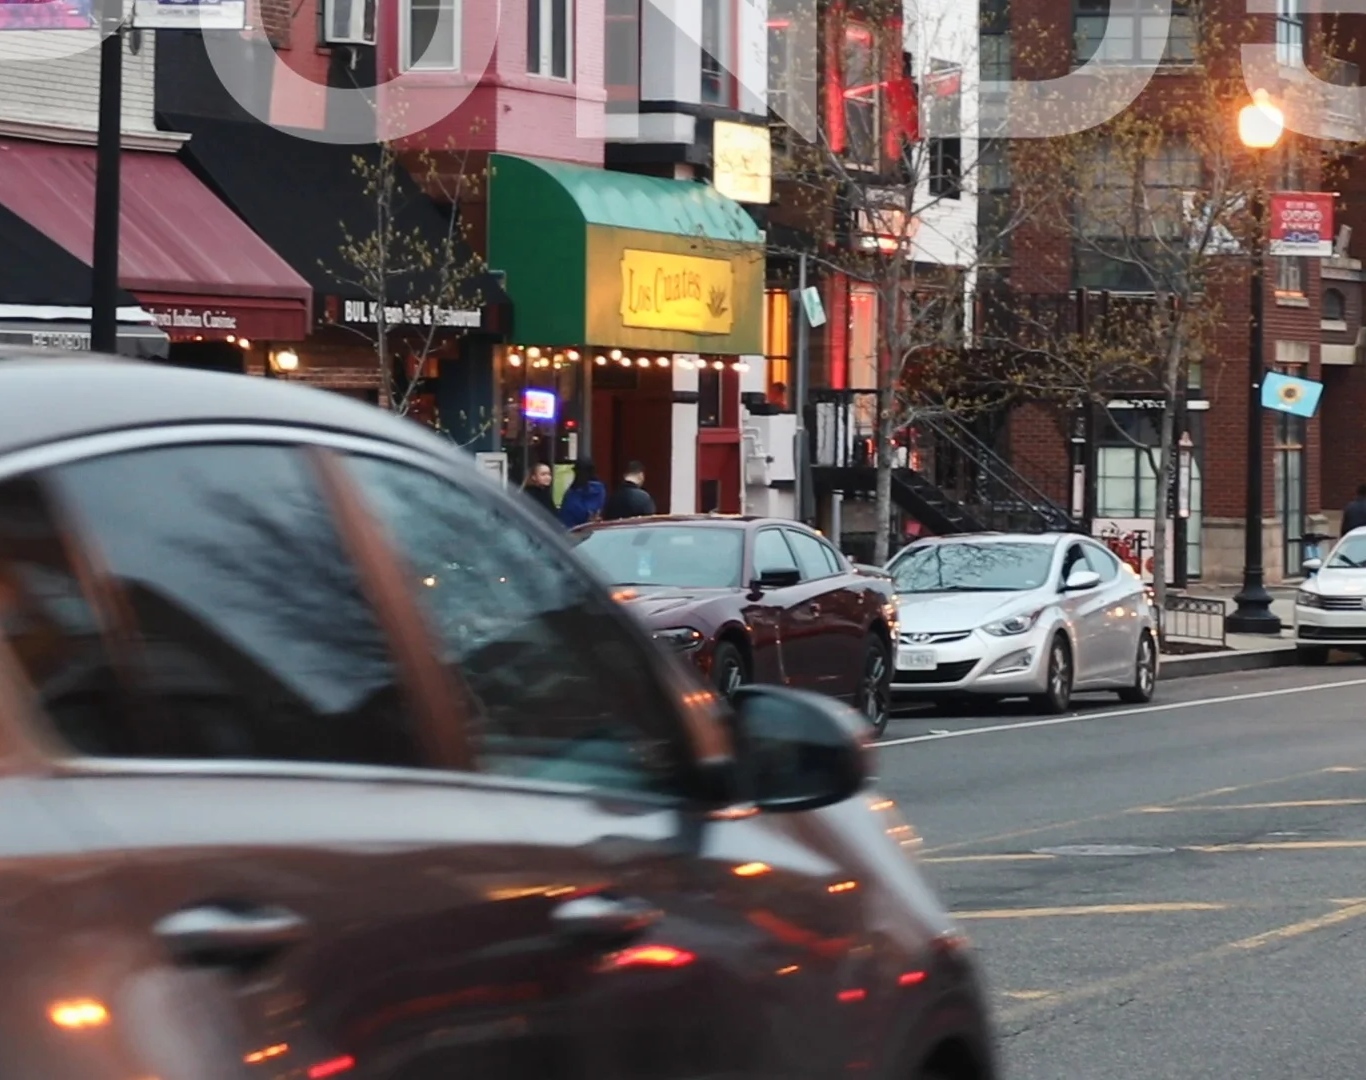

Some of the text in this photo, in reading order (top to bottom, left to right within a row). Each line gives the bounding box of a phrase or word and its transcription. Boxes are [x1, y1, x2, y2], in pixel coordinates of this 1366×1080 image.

[653, 265, 702, 314] Cuates
[173, 309, 203, 328] Indian
[203, 310, 238, 329] Cuisine
[344, 300, 369, 323] BUL
